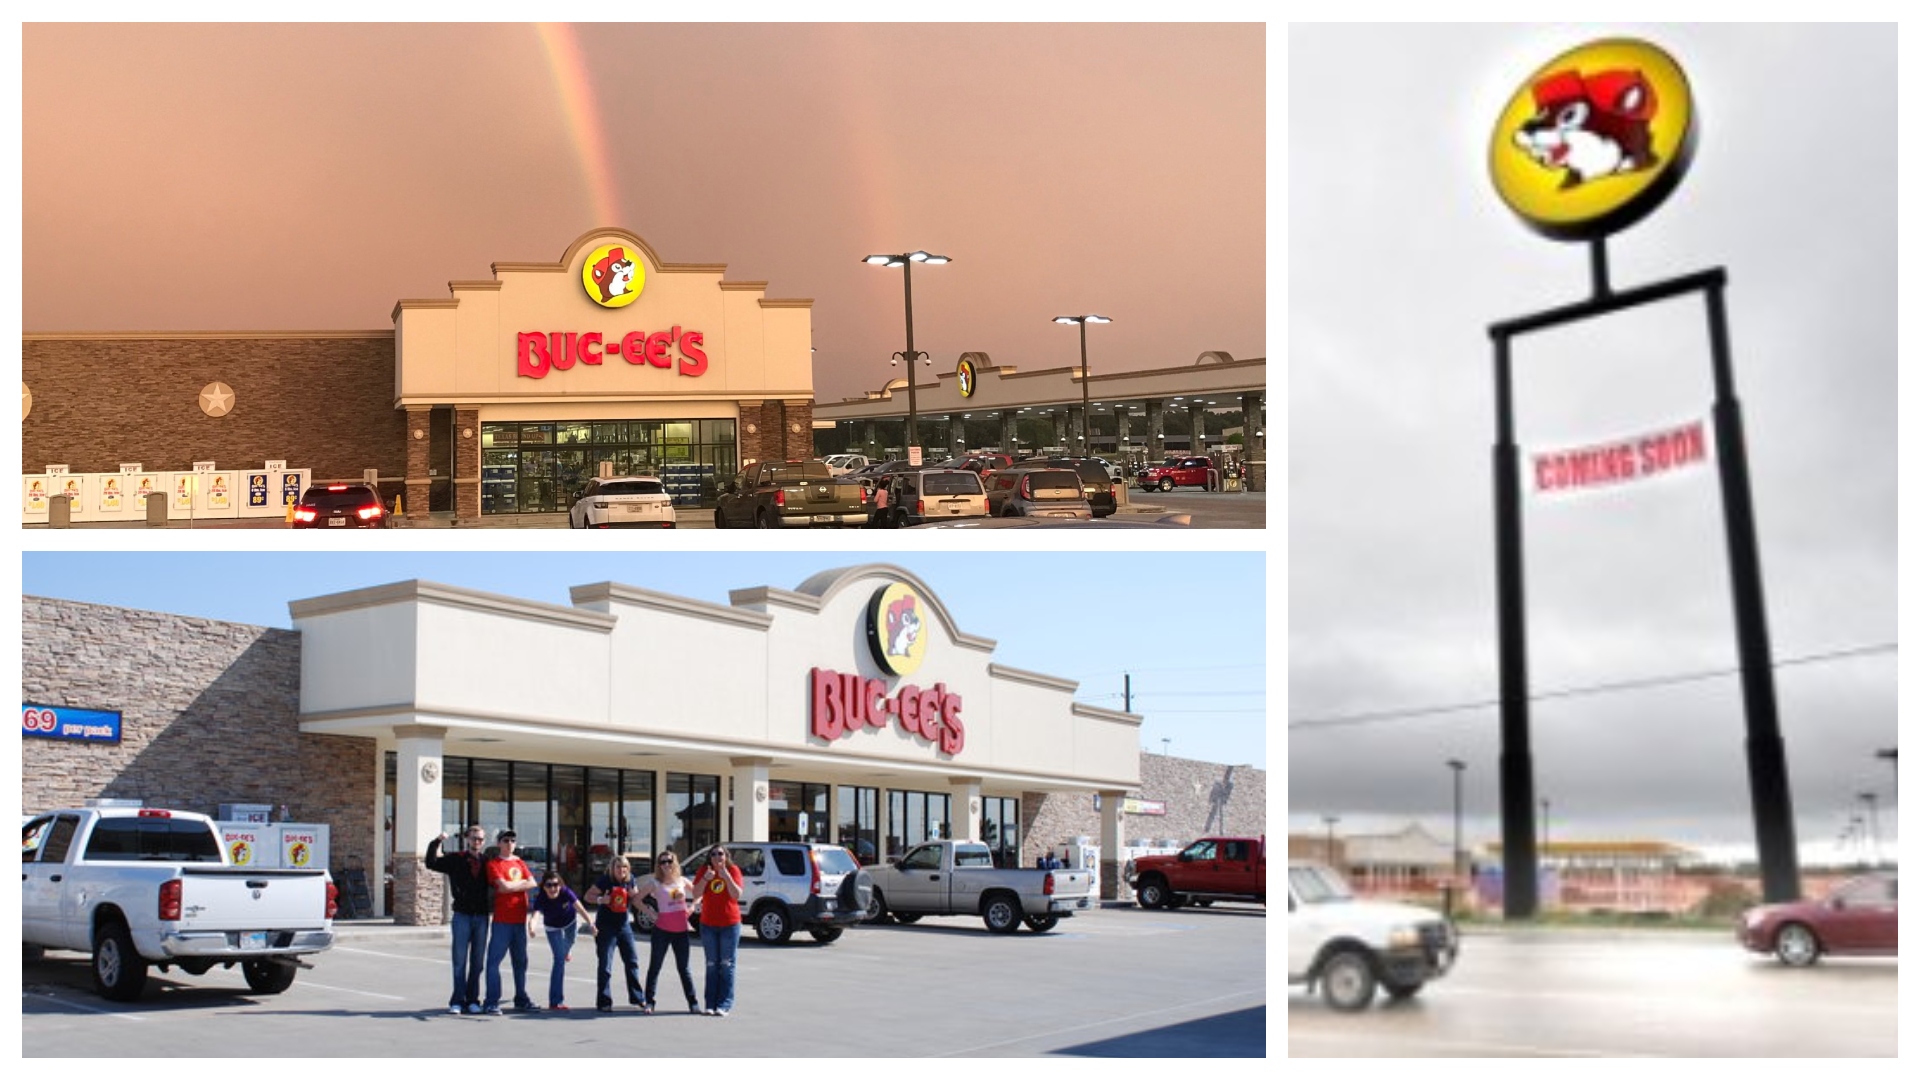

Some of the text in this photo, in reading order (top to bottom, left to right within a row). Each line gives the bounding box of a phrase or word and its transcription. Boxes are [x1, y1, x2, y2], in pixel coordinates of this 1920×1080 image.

[517, 325, 709, 380] BUC-EE'S
[1535, 421, 1705, 491] COMING SOON
[63, 724, 83, 735] per
[84, 725, 113, 737] pack
[811, 667, 965, 756] BUC-EE'S
[248, 813, 266, 823] ICE
